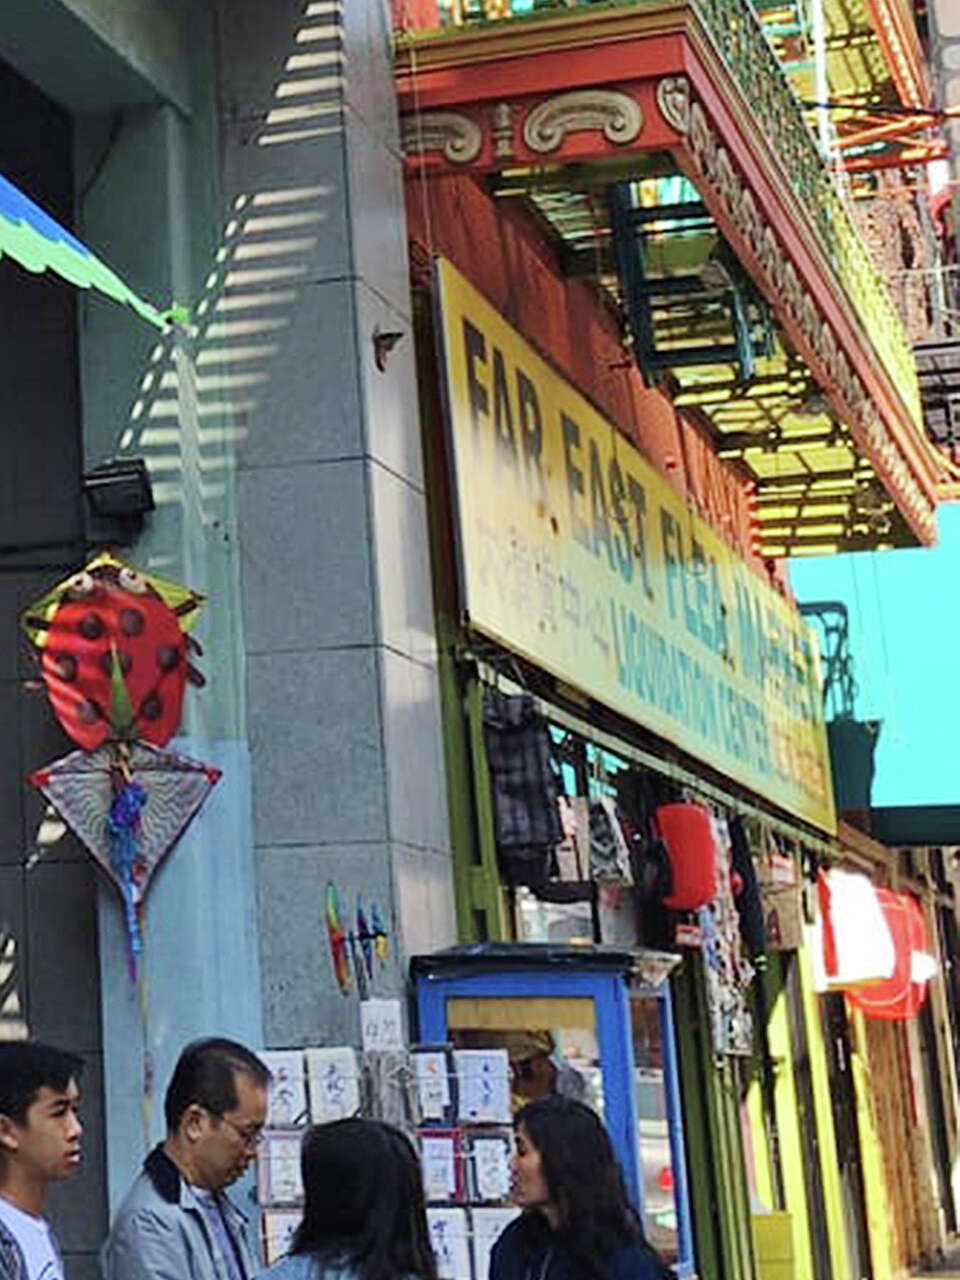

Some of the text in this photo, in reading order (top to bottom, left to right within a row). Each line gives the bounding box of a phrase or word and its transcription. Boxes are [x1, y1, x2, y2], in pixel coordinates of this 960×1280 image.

[461, 316, 547, 505] FAR
[560, 410, 653, 603] EAST
[661, 506, 732, 665] FLEA
